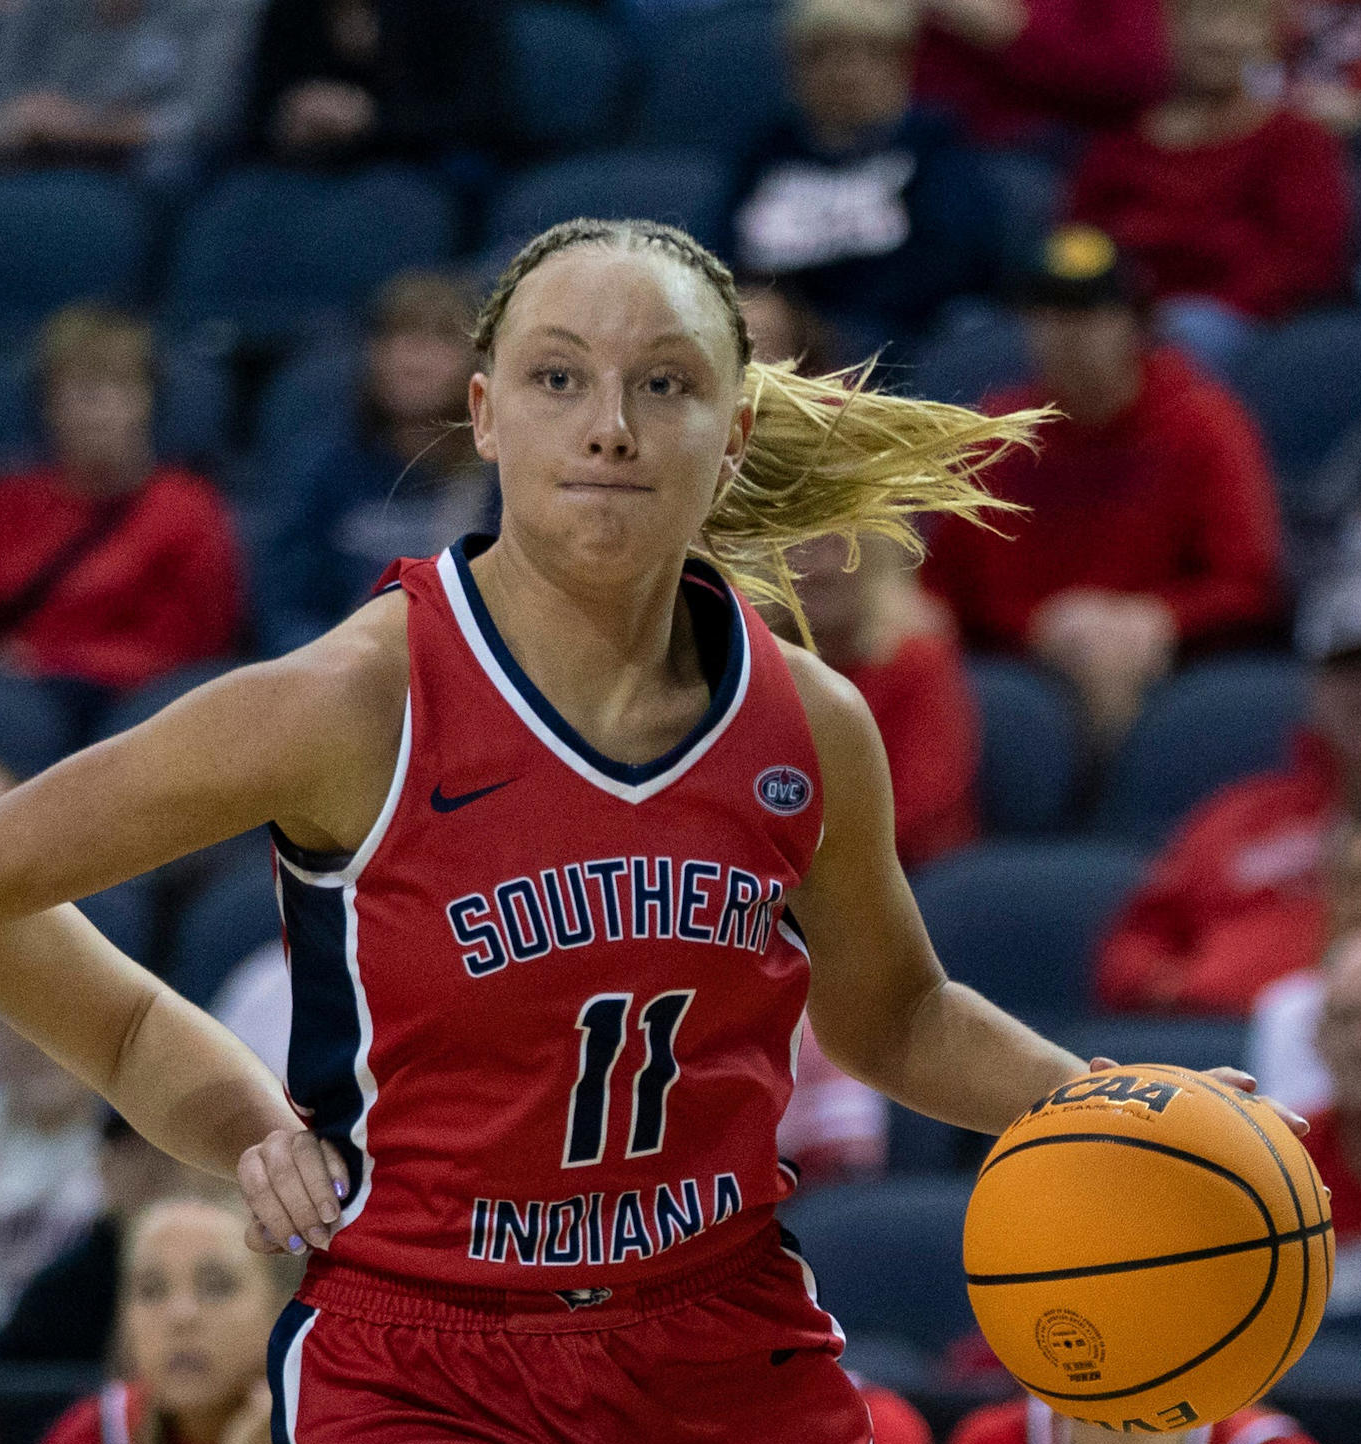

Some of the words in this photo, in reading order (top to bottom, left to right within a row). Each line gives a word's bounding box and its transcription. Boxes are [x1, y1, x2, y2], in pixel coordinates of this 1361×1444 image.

[767, 781, 799, 801] OVC
[446, 856, 783, 978] SOUTHERN
[561, 989, 697, 1170] 11
[467, 1172, 745, 1267] INDIANA
